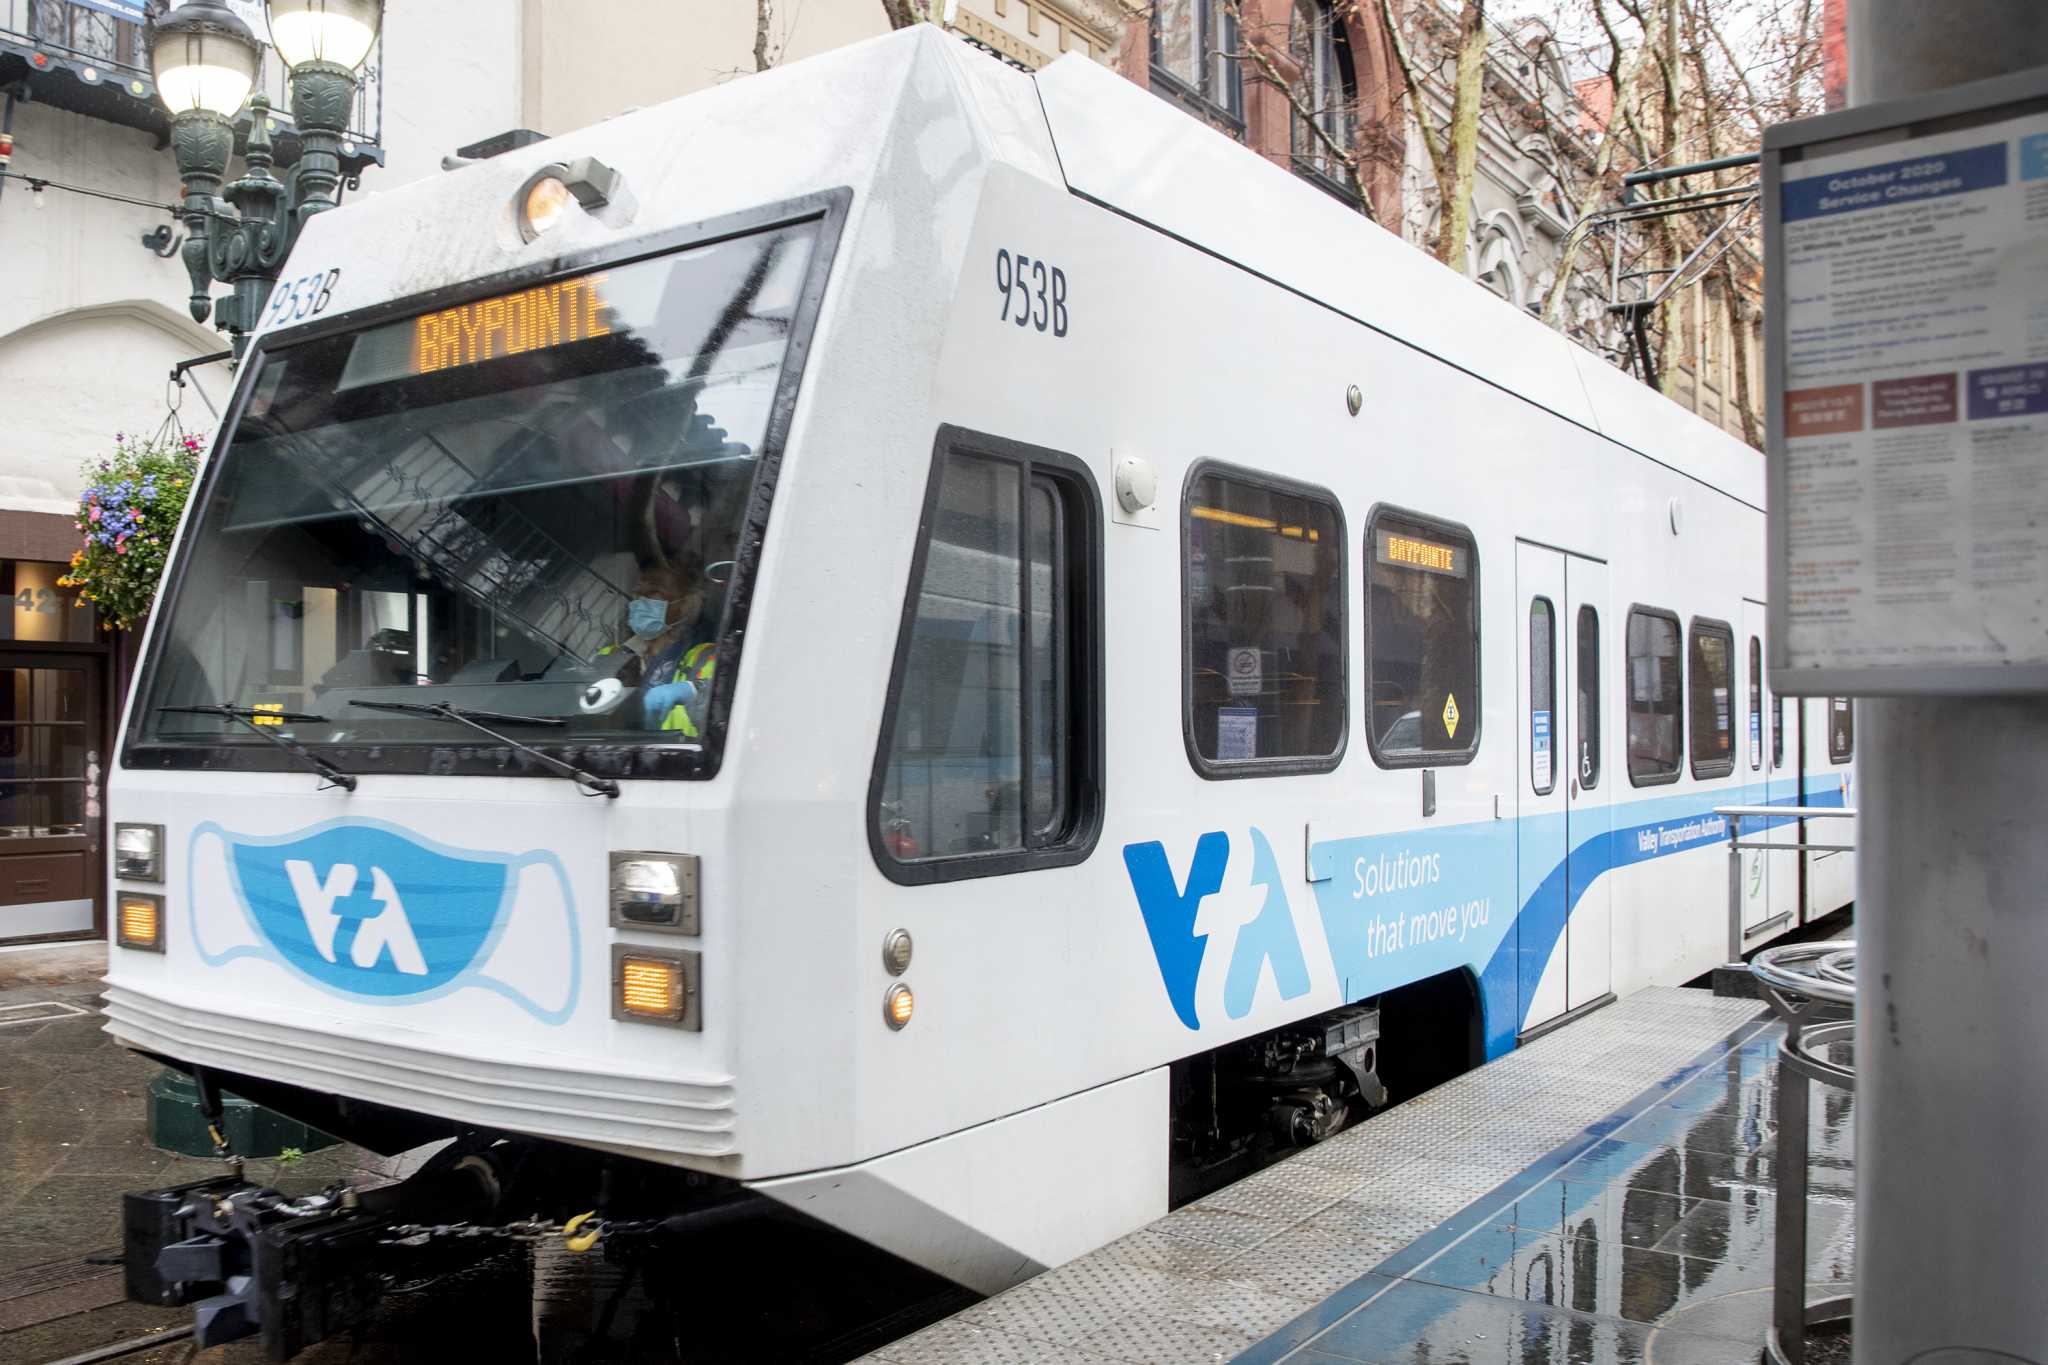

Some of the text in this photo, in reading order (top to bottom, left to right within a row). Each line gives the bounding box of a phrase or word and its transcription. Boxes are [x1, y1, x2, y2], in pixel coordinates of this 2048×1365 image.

[1819, 177, 1963, 210] Service Changes
[1829, 161, 1945, 192] October 2020
[265, 268, 340, 327] 953B
[996, 248, 1068, 338] 953B
[419, 273, 611, 375] BAYPOINTE
[1388, 536, 1454, 571] BAYPOINTE
[15, 586, 57, 614] 42
[1638, 815, 1727, 854] Valley Transportation Authority
[1353, 850, 1441, 898] Solutions
[285, 859, 428, 975] VTA
[1122, 825, 1312, 1031] VTA
[1367, 896, 1490, 959] that move you
